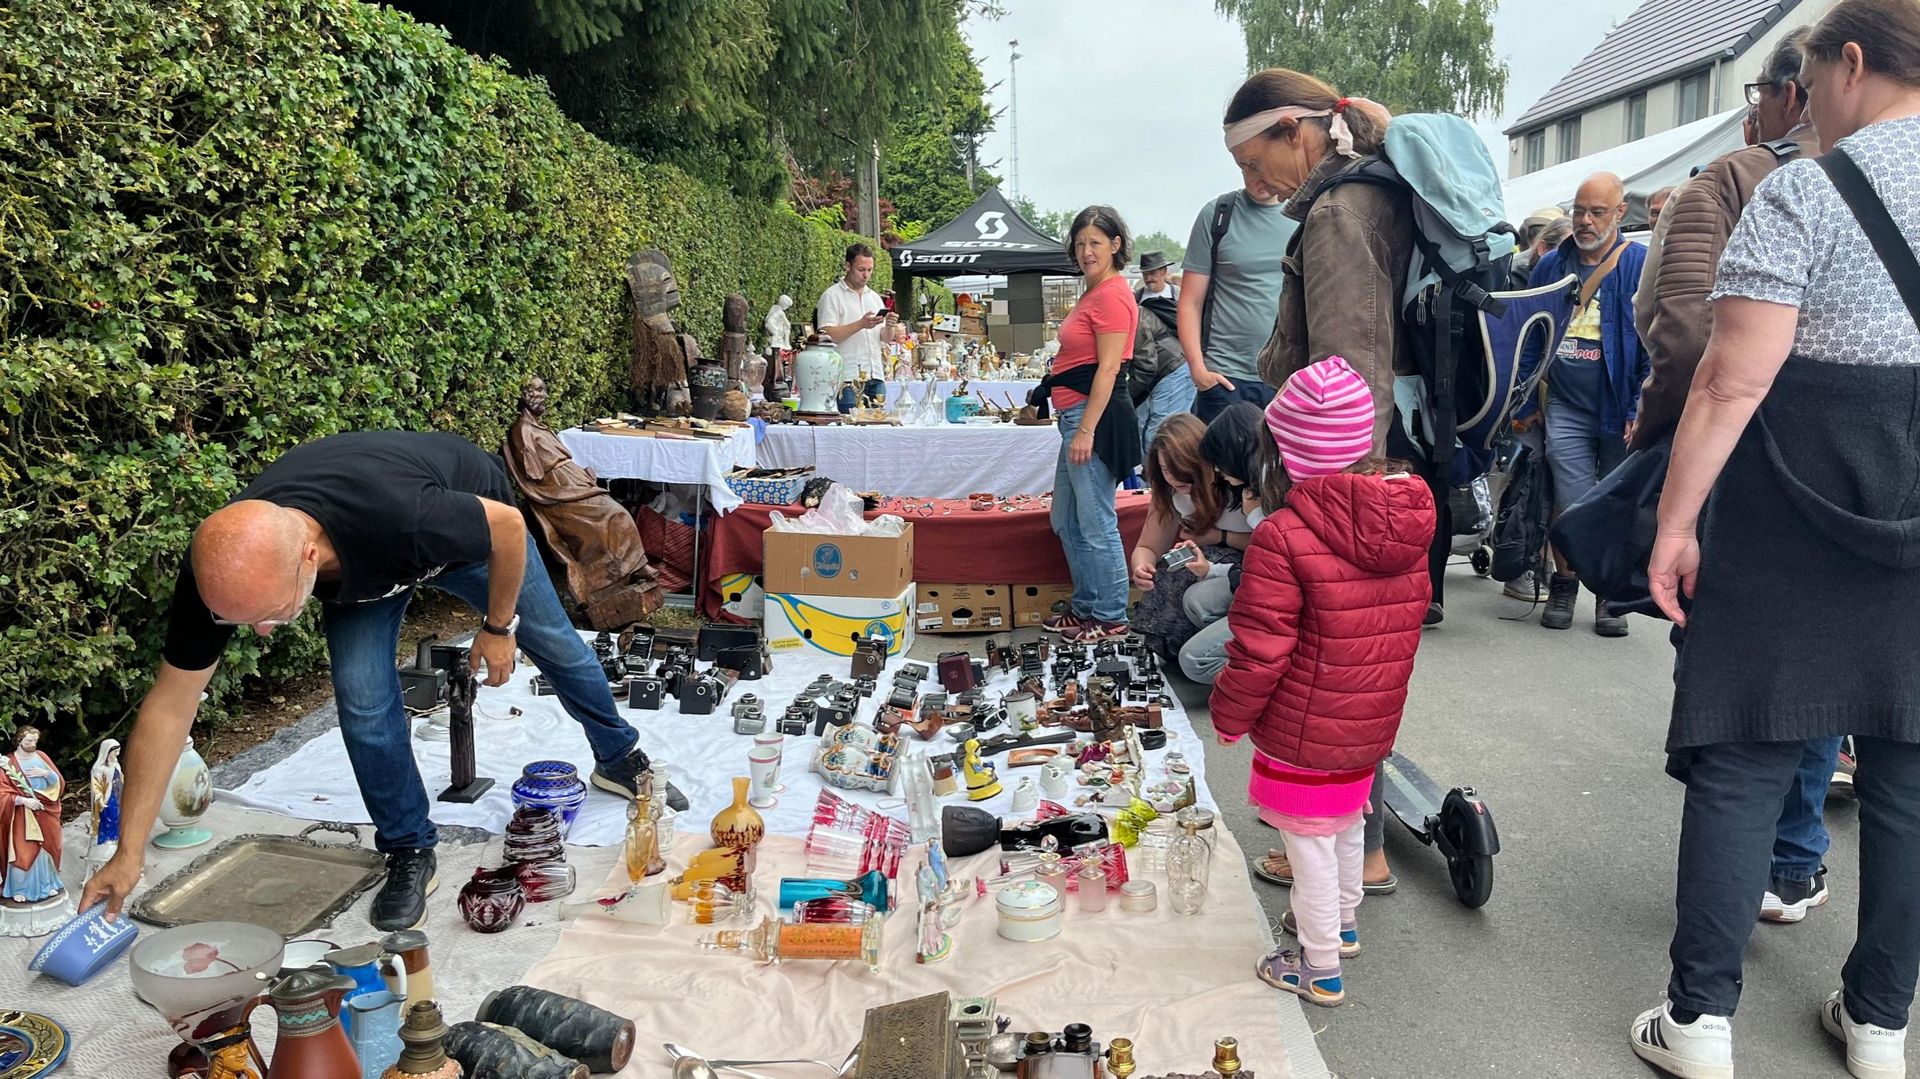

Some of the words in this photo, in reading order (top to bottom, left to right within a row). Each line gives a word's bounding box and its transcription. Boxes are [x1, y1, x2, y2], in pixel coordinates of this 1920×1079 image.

[941, 241, 1038, 249] SCOTT
[914, 254, 982, 264] SCOTT
[1870, 1029, 1896, 1037] adidas
